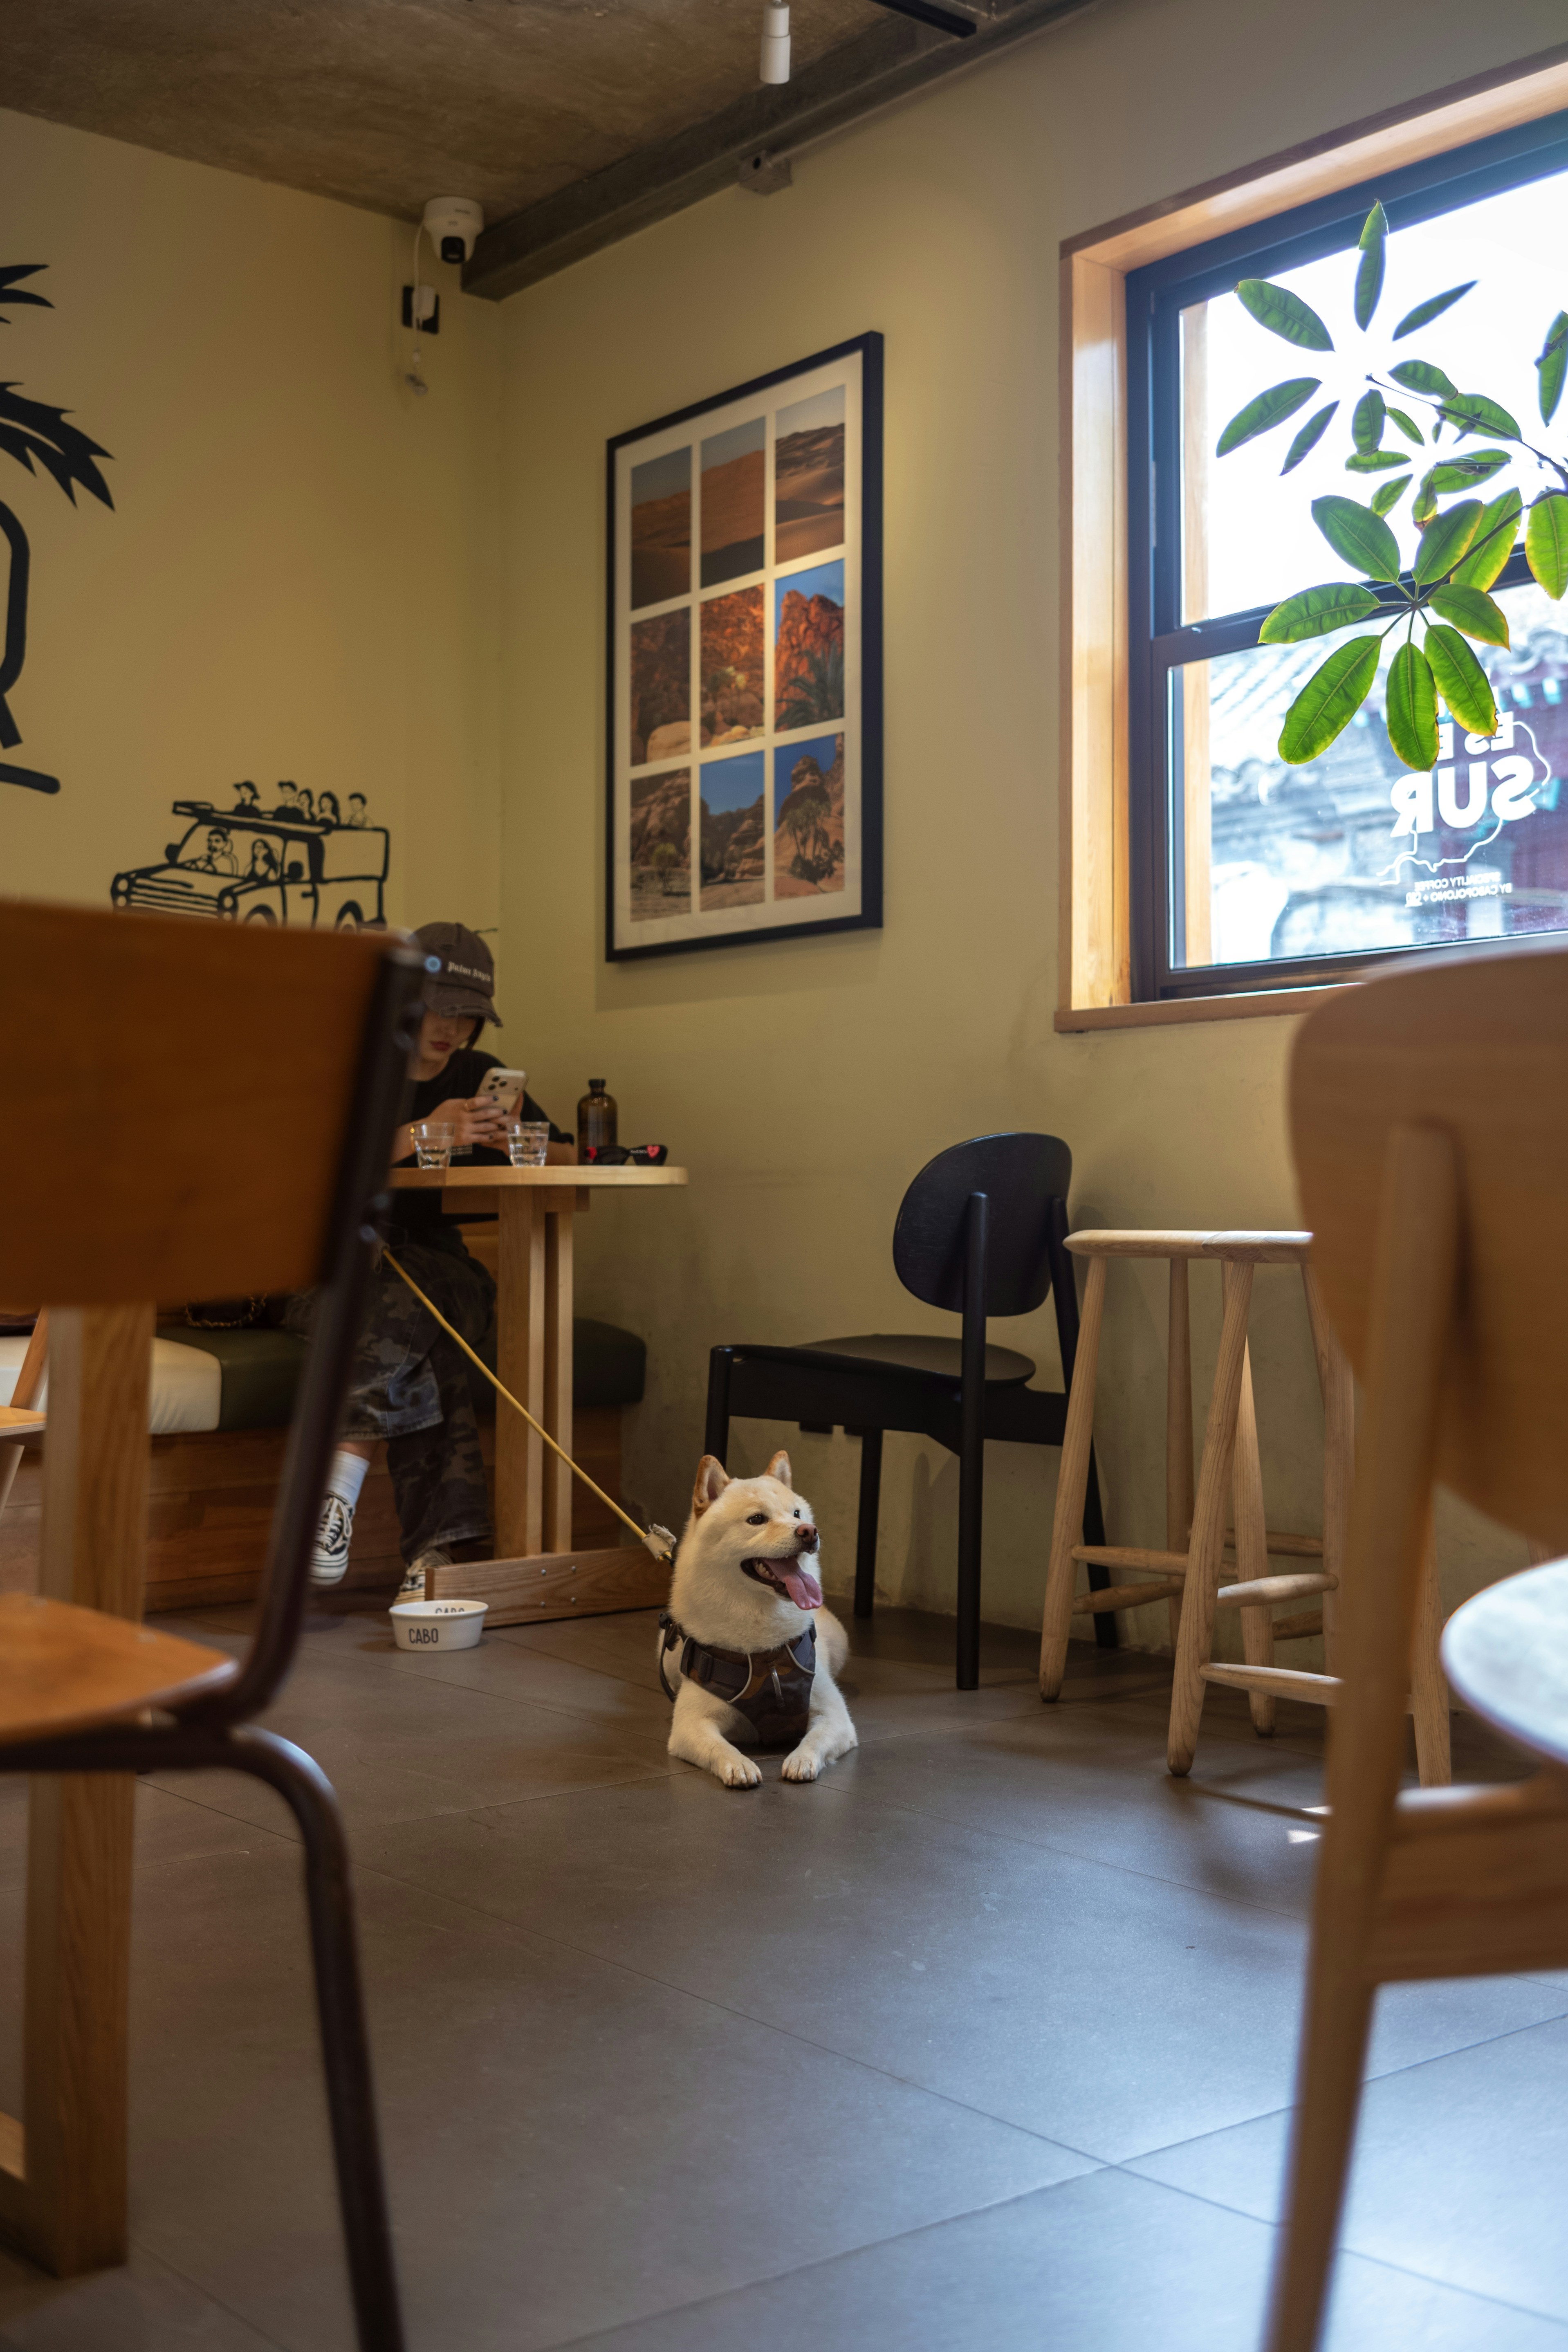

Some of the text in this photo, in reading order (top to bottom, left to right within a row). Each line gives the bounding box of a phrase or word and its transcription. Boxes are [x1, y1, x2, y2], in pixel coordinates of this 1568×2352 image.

[447, 961, 491, 982] Palm Angels
[409, 1628, 439, 1643] CABO
